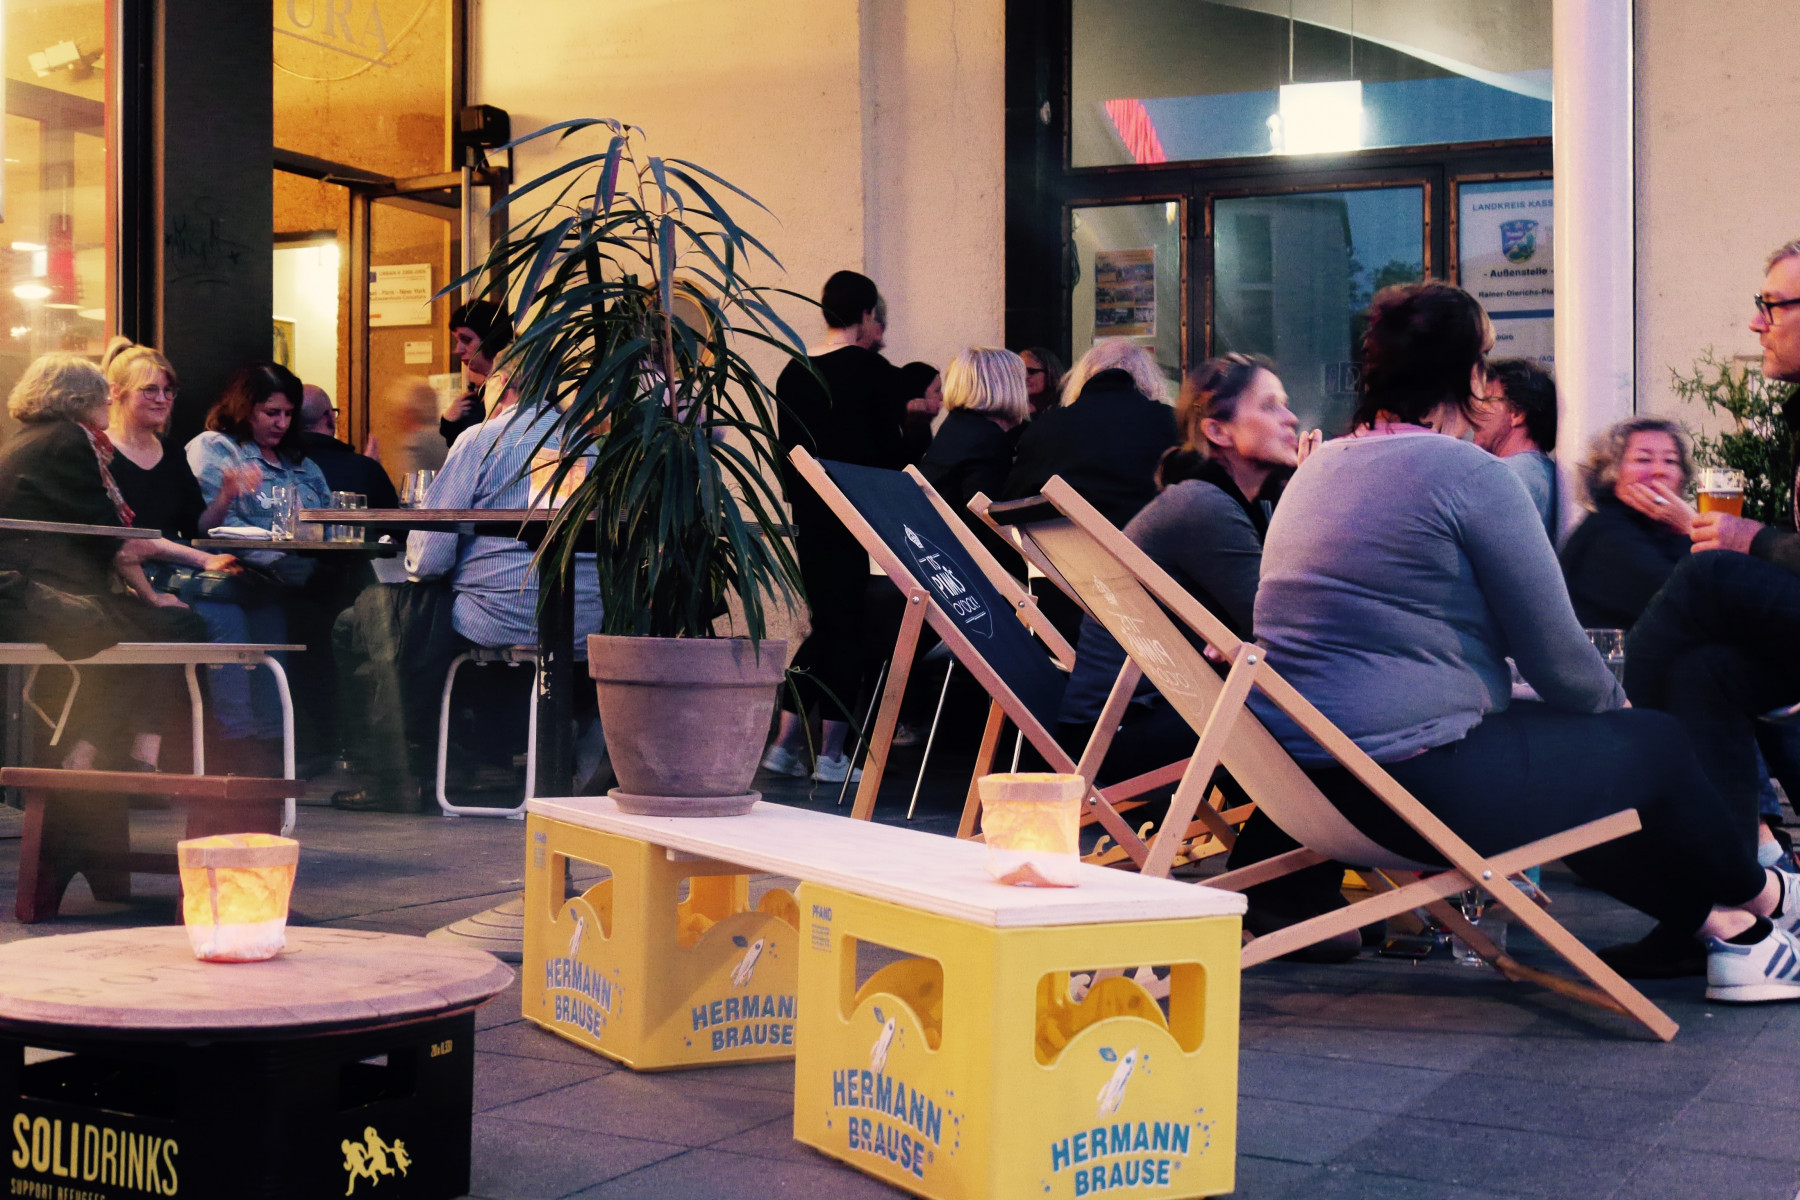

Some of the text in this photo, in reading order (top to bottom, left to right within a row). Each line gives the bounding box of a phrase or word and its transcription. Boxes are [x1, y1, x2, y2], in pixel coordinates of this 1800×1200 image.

[1472, 200, 1526, 211] LANDKREIS
[1490, 267, 1548, 278] Außenstelle
[546, 957, 613, 1014] HERMANN
[555, 994, 602, 1041] BRAUSE
[691, 994, 798, 1032] HERMAN
[711, 1022, 795, 1052] BRAUSE
[833, 1068, 942, 1147] HERMANN
[848, 1115, 925, 1180] BRAUSE
[1051, 1120, 1191, 1173] HERMANN
[11, 1177, 53, 1200] SUPPORT
[1074, 1158, 1171, 1198] BRAUSE
